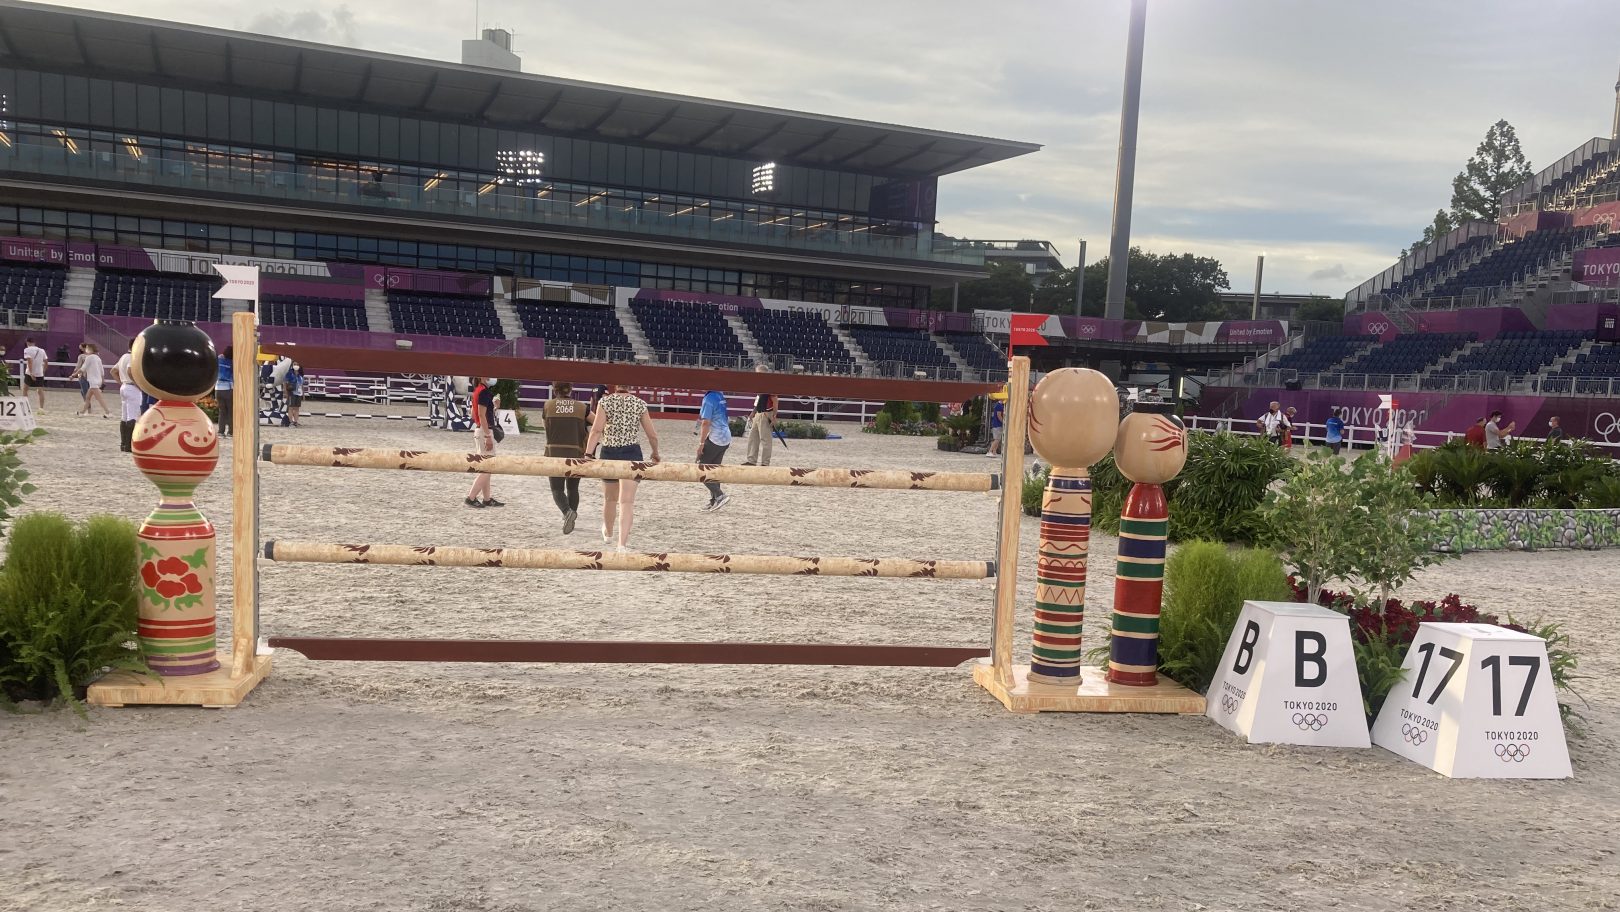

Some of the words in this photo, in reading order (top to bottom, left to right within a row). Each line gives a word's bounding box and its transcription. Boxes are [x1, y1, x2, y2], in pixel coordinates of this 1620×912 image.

[50, 249, 63, 260] by
[68, 250, 113, 264] Emoton
[1583, 262, 1620, 276] TOKYO
[985, 316, 1011, 329] TOK
[0, 401, 17, 417] 12
[555, 405, 575, 414] 2068
[504, 412, 511, 424] 4
[1232, 619, 1260, 675] B
[1294, 630, 1328, 688] B
[1411, 642, 1465, 706] 17
[1480, 655, 1541, 717] 17
[1283, 700, 1314, 711] TOKYO
[1315, 701, 1338, 711] 2020
[1400, 708, 1422, 724] TOKYO
[1421, 717, 1439, 731] 2020
[1484, 731, 1515, 741] TOKYO
[1516, 731, 1539, 741] 2020
